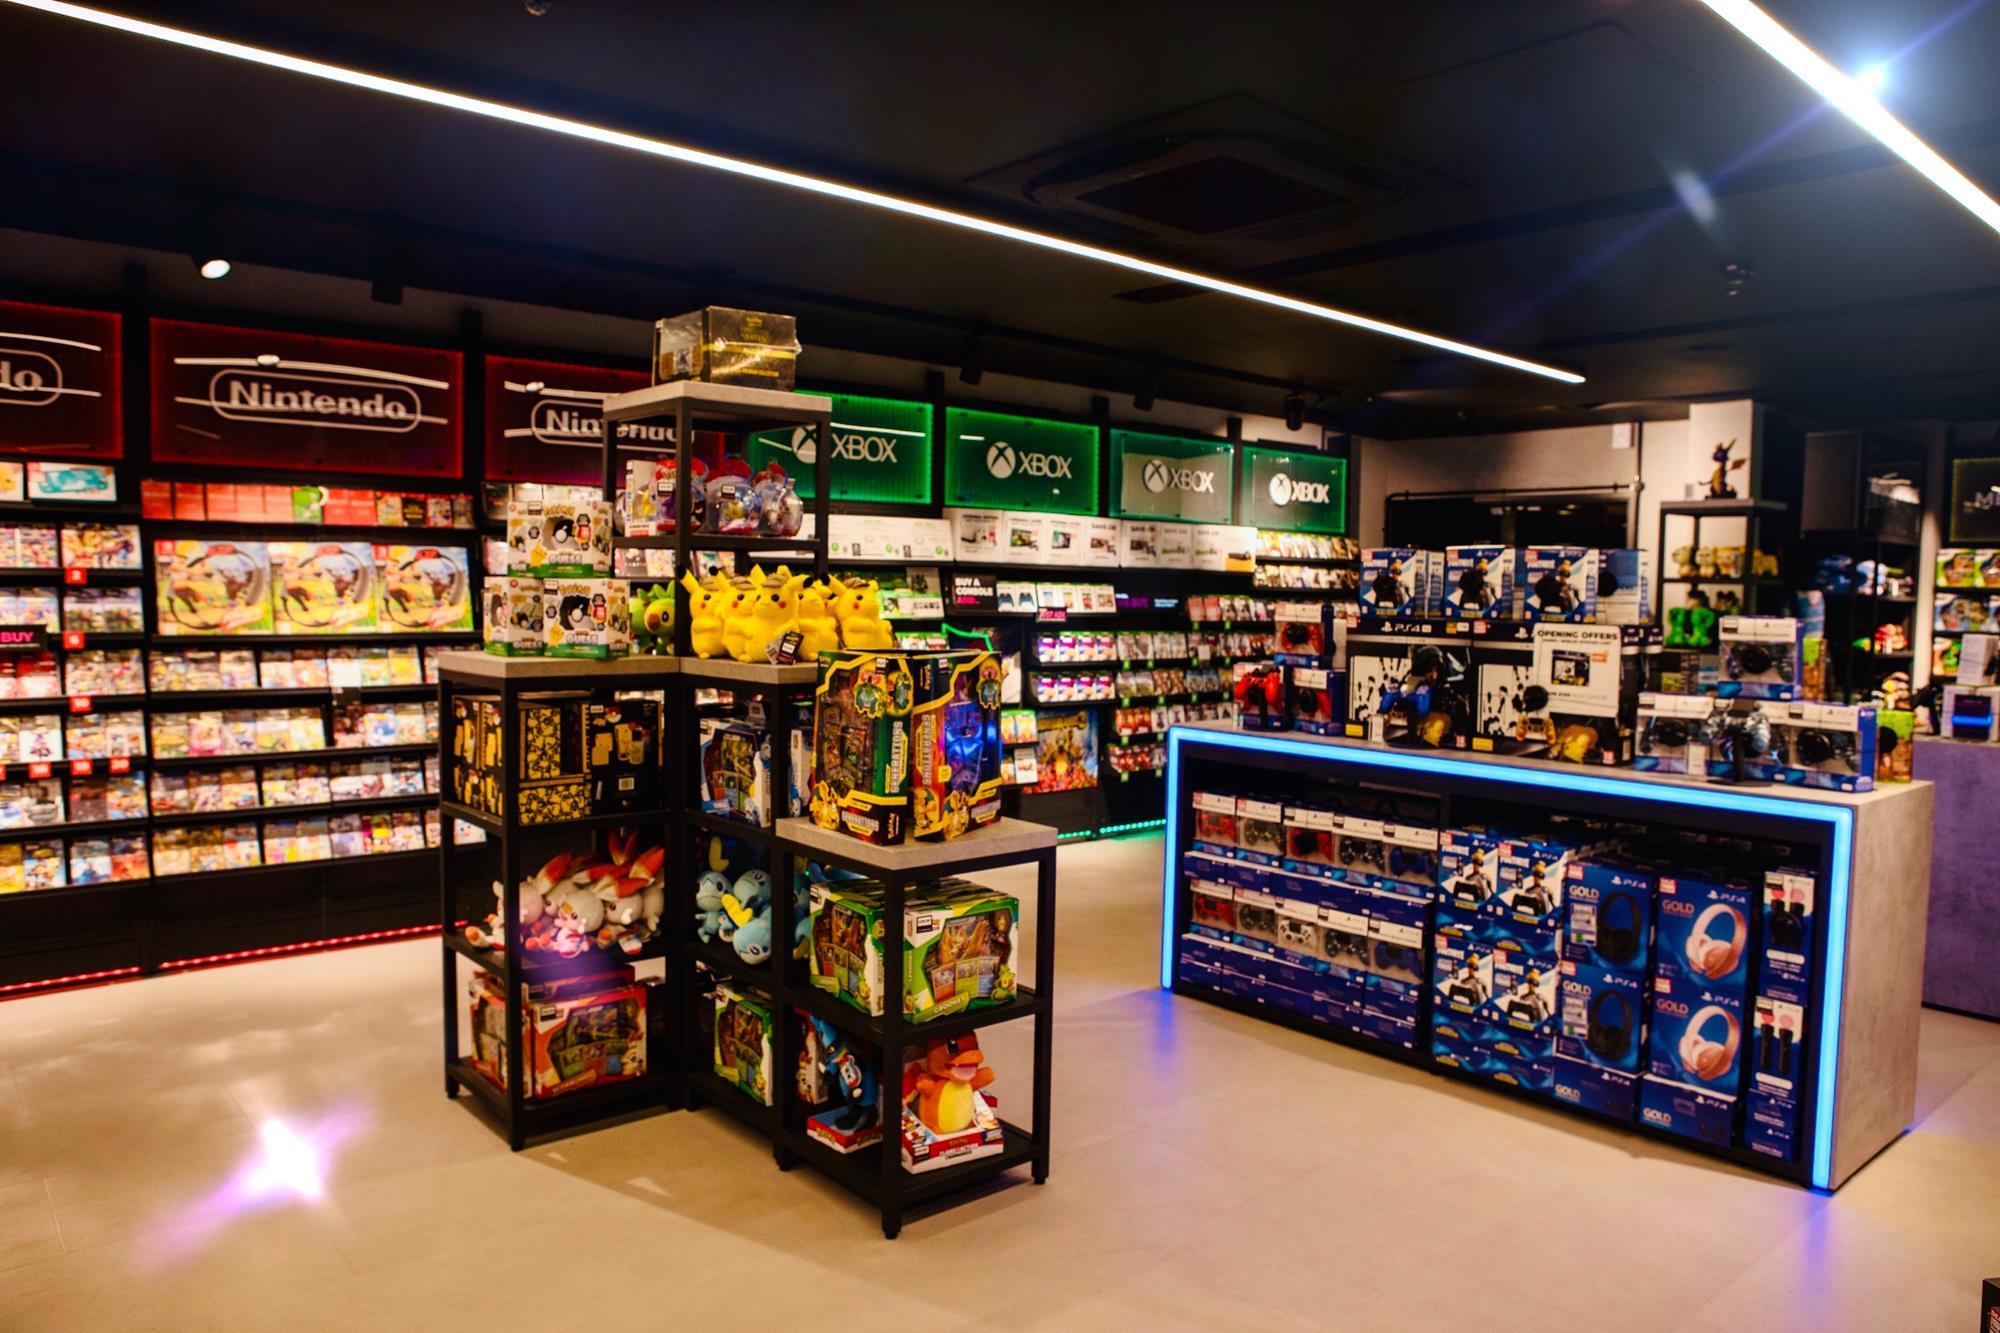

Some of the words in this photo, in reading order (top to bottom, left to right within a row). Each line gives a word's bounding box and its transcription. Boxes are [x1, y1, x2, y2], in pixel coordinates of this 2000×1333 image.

[230, 380, 407, 420] Nintendo
[831, 433, 898, 463] XBOX
[1019, 452, 1072, 479] XBOX
[1170, 468, 1214, 493] XBOX
[1291, 481, 1329, 503] XBOX
[1394, 624, 1421, 633] PS4
[1538, 630, 1578, 639] OPENING
[1582, 631, 1618, 640] OFFERS
[0, 632, 34, 642] BUY
[891, 721, 903, 793] GENERATIONS
[1569, 885, 1599, 898] GOLD
[1720, 893, 1746, 903] PS4
[1662, 900, 1695, 914] GOLD
[1563, 980, 1591, 995] GOLD
[1657, 998, 1689, 1014] GOLD
[1555, 1084, 1581, 1099] GOLD
[1643, 1107, 1671, 1123] GOLD
